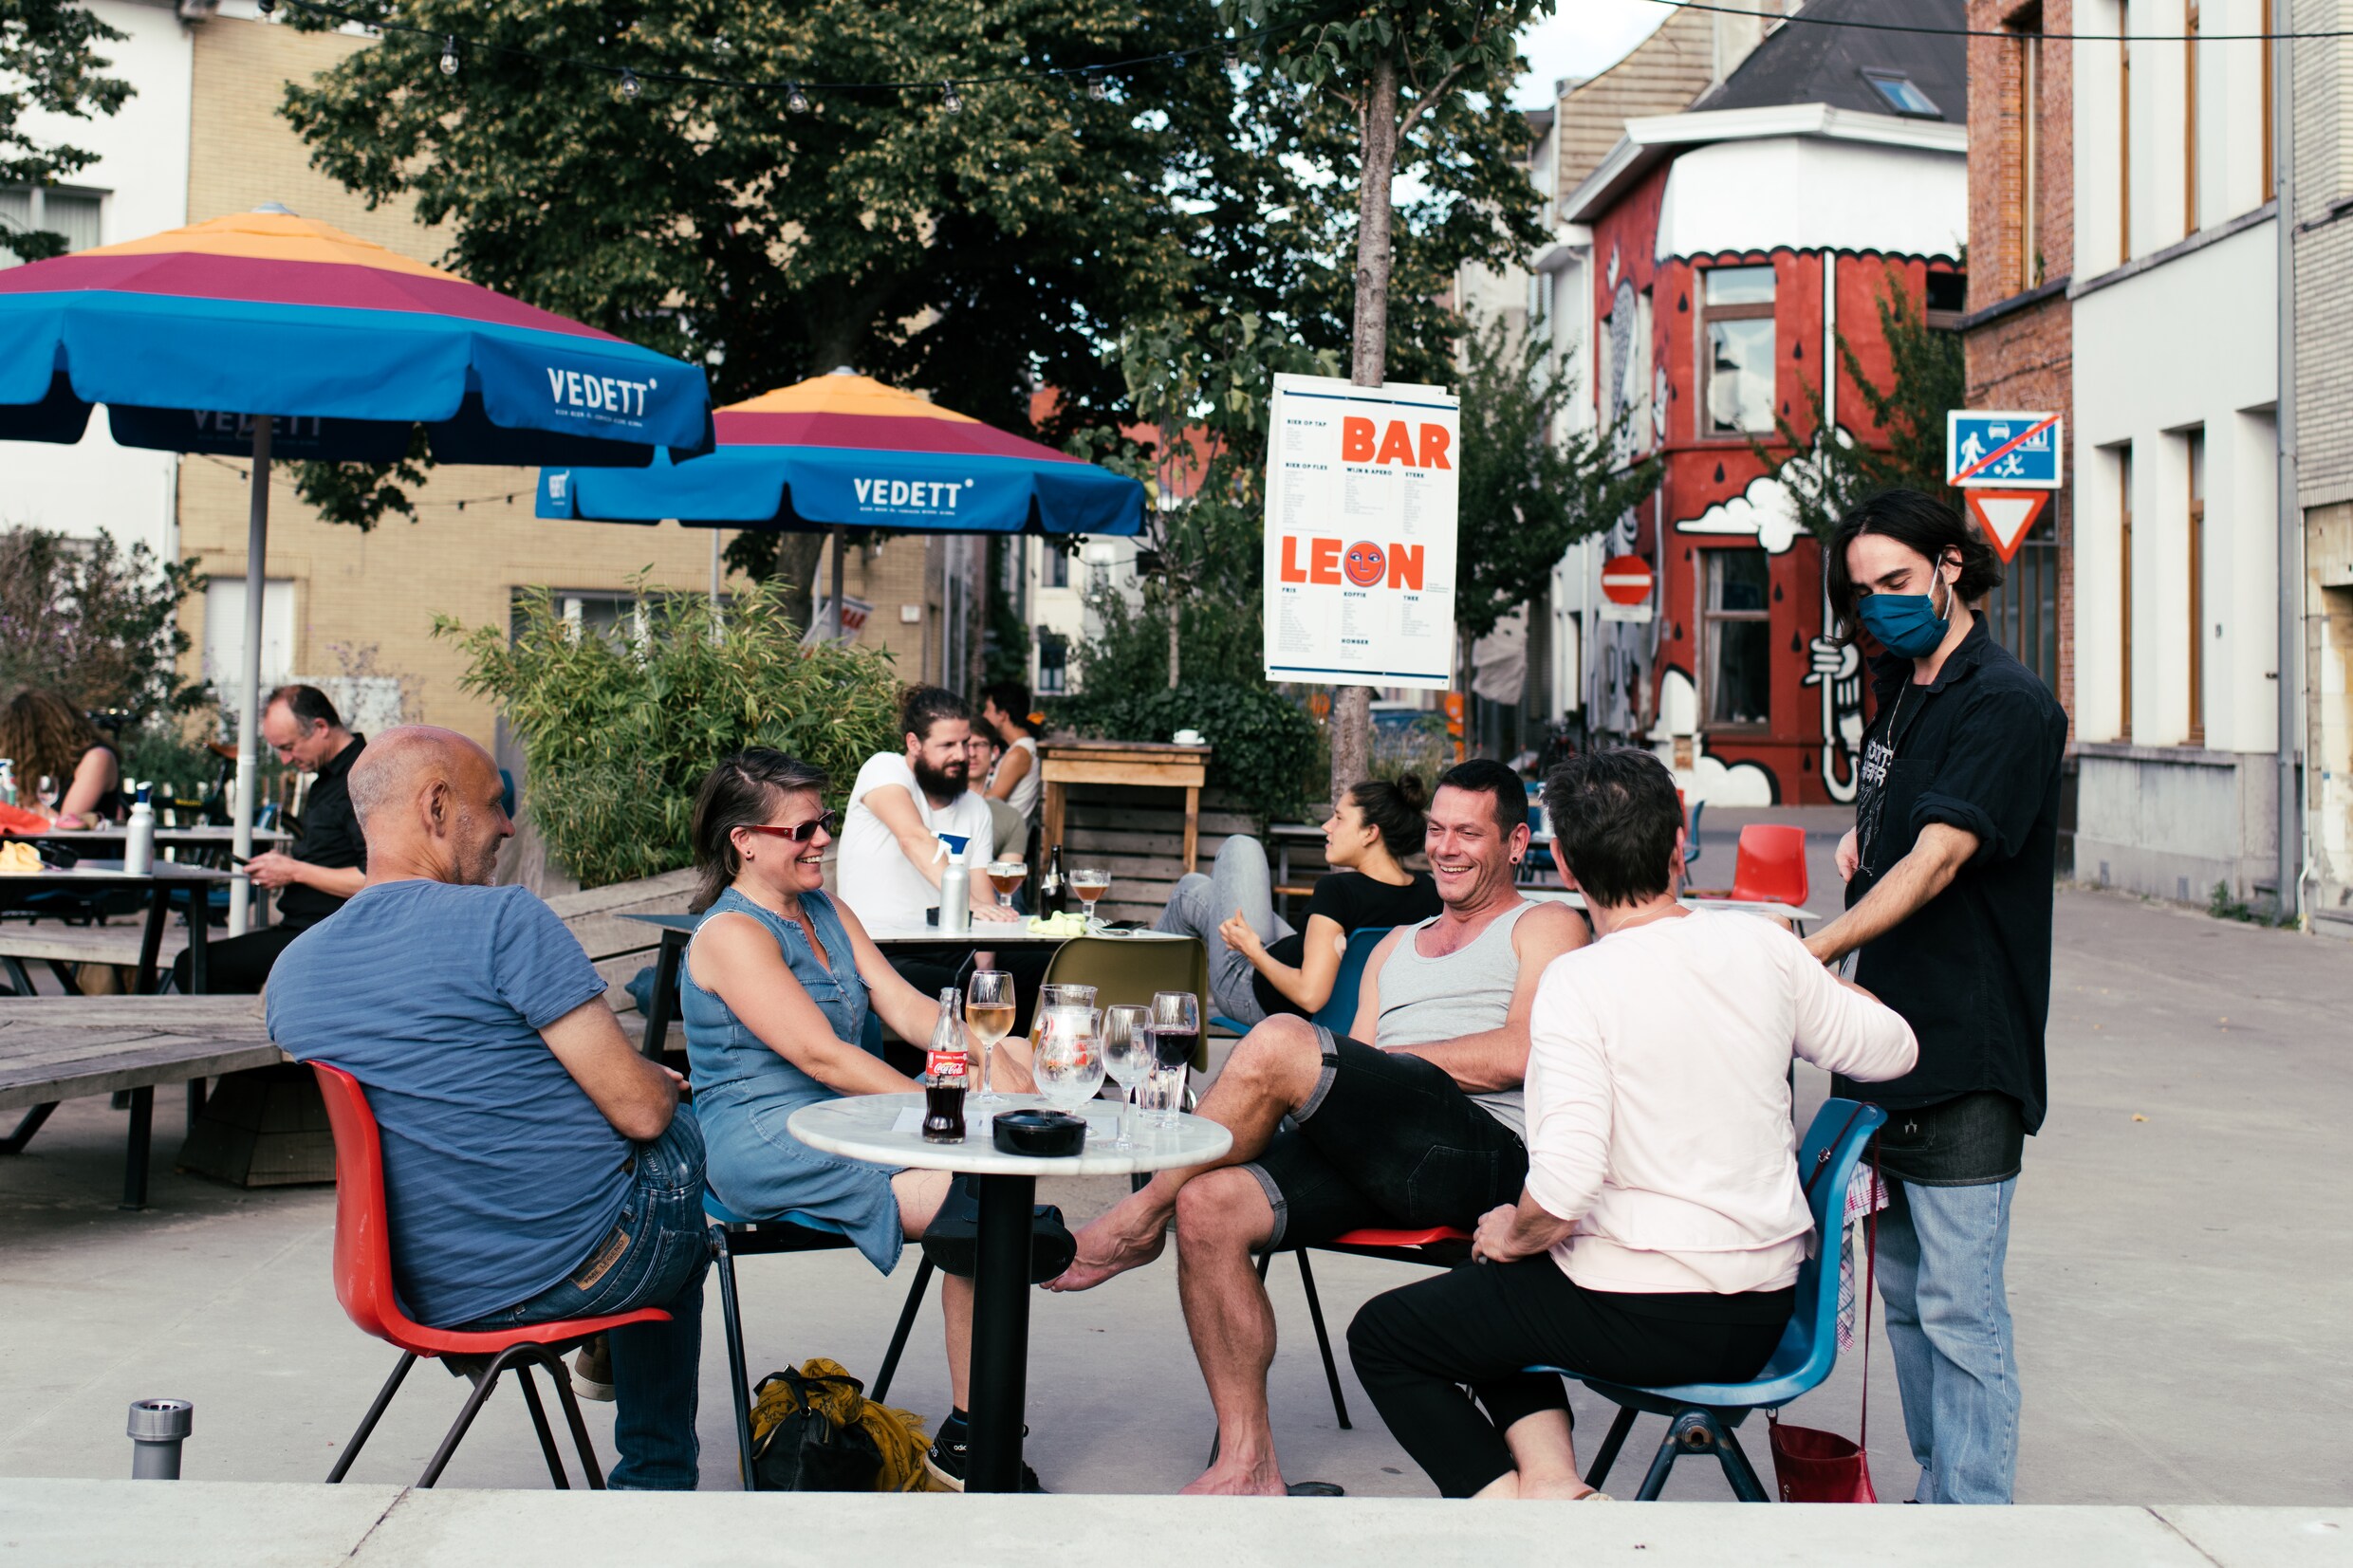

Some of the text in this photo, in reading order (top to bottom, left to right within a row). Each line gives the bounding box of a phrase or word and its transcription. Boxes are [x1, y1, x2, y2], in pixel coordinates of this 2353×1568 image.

[547, 367, 647, 416] VEDETT
[1342, 415, 1452, 470] BAR
[854, 478, 962, 508] VEDETT
[584, 1268, 600, 1283] PME
[600, 1240, 624, 1269] LEGEND
